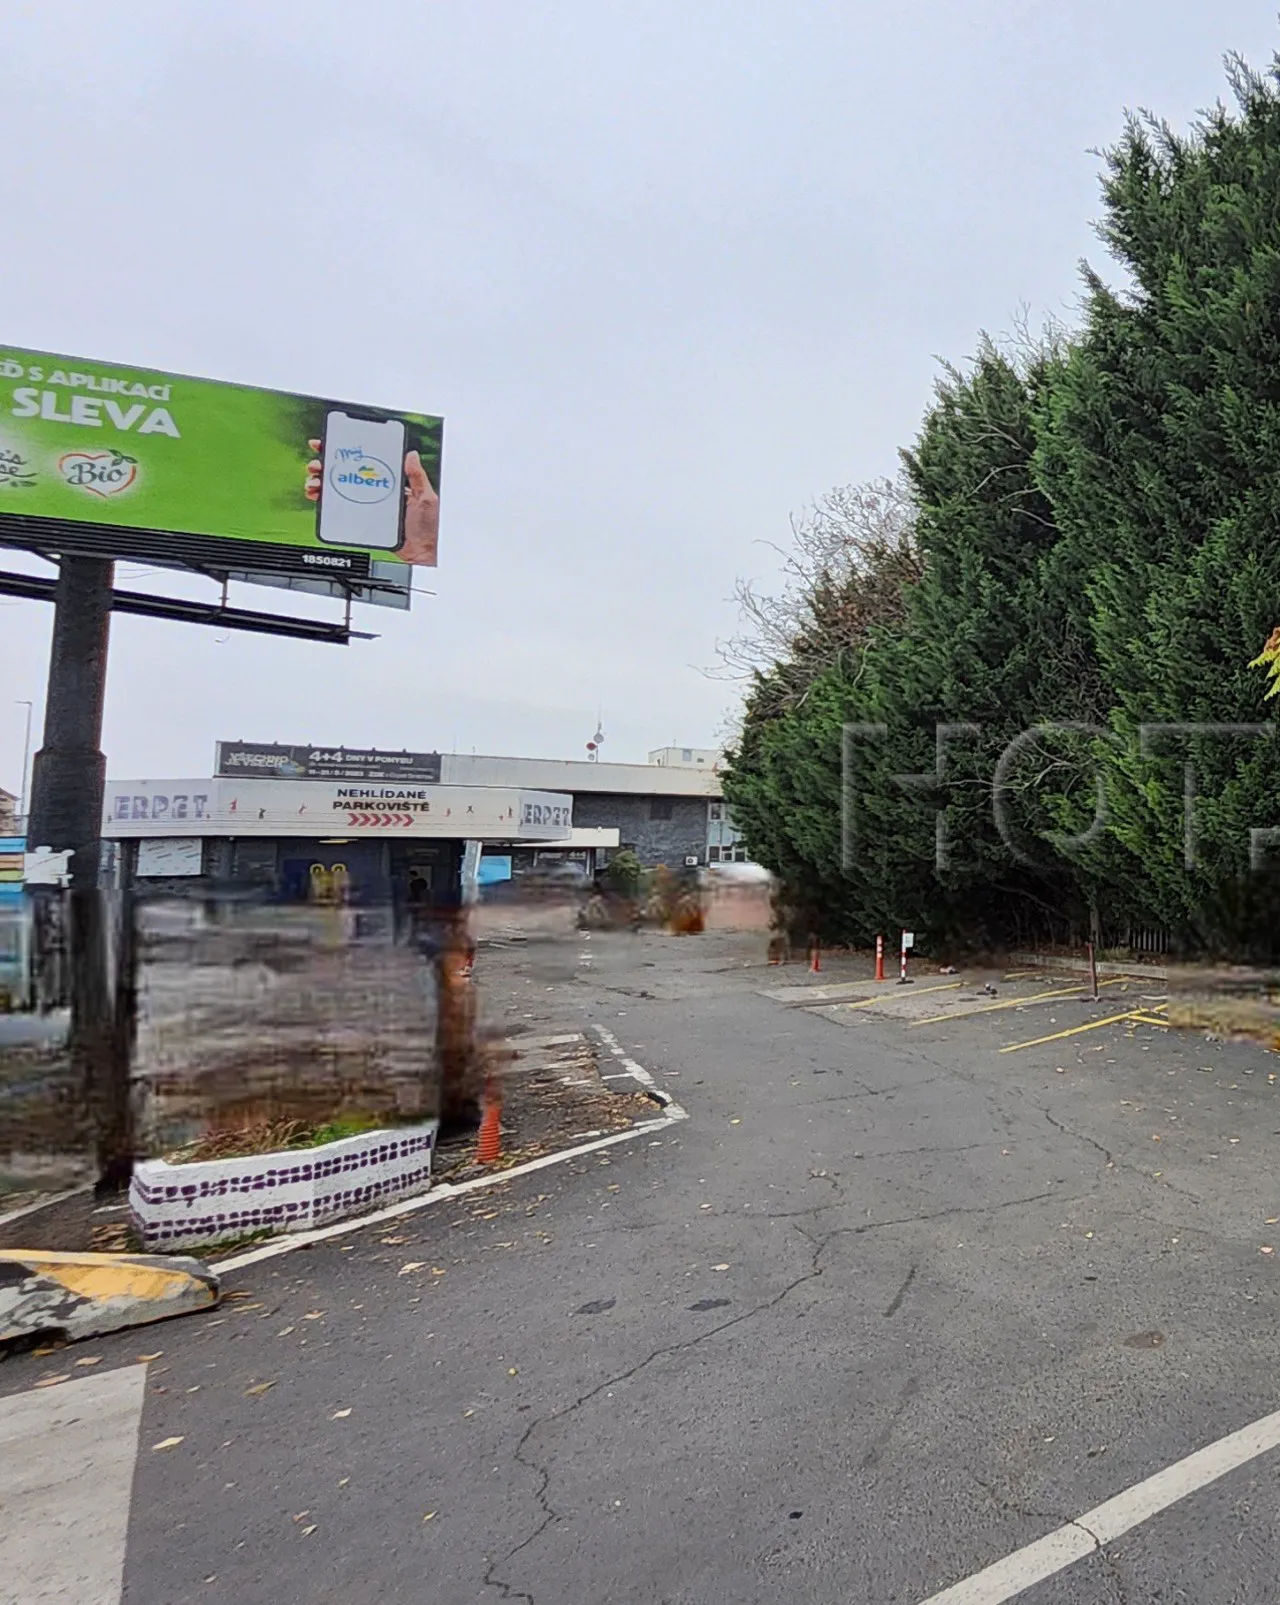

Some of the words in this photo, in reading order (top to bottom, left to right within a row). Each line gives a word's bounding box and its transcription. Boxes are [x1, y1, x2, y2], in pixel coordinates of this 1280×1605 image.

[28, 366, 44, 382] S
[47, 370, 173, 401] APLIKACÍ
[12, 387, 181, 438] SLEVA
[67, 462, 127, 485] Bio
[337, 472, 389, 489] albert
[302, 554, 351, 567] 1850821
[308, 751, 343, 762] 4+4
[336, 788, 427, 800] NEHLÍDANÉ
[114, 795, 208, 819] ERPET
[332, 801, 430, 812] PARKOVIŠTĚ
[523, 803, 570, 826] ERPET
